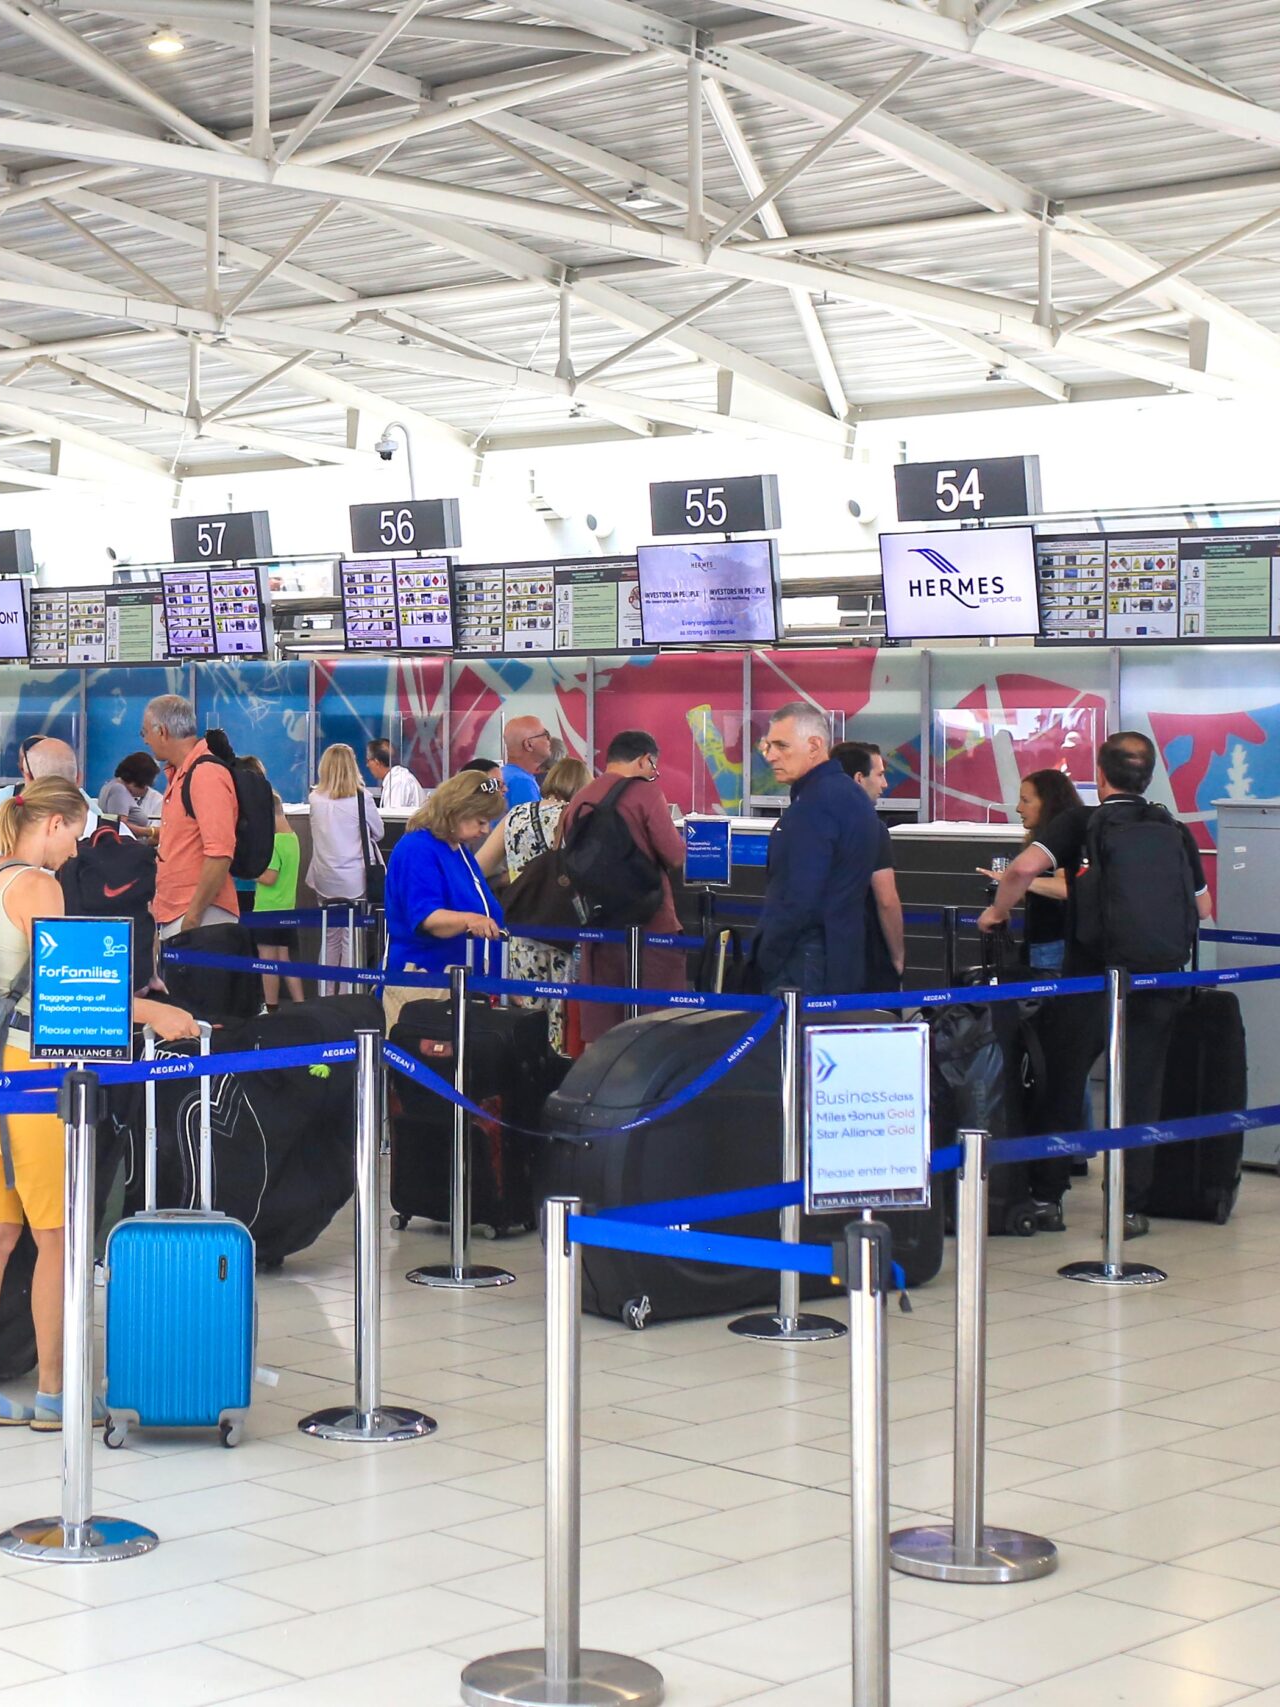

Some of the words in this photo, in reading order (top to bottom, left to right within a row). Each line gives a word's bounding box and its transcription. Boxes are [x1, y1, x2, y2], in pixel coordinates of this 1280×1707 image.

[936, 468, 984, 512] 54
[685, 487, 727, 527] 55
[380, 509, 415, 545] 56
[197, 522, 227, 555] 57
[691, 561, 714, 569] HERMES
[909, 576, 1005, 600] HERMES
[979, 596, 1022, 605] airports
[39, 965, 118, 978] ForFamilies
[535, 987, 562, 995] AEGEAN
[39, 994, 74, 1003] Baggage
[76, 993, 94, 1002] drop
[670, 996, 699, 1004] AEGEAN
[39, 1025, 71, 1035] Please
[73, 1026, 98, 1035] enter
[100, 1025, 123, 1035] here
[41, 1048, 64, 1056] STAR
[66, 1049, 112, 1057] ALLIANCE
[322, 1048, 356, 1057] AEGEAN
[727, 1041, 750, 1063] AEGEAN
[150, 1065, 186, 1074] AEGEAN
[887, 1108, 914, 1120] Gold
[817, 1129, 838, 1139] Star
[841, 1127, 885, 1138] Alliance
[888, 1125, 915, 1136] Gold
[817, 1168, 855, 1179] Please
[858, 1167, 887, 1177] enter
[890, 1164, 917, 1175] here
[817, 1198, 839, 1206] STAR
[840, 1196, 880, 1205] ALLIANCE
